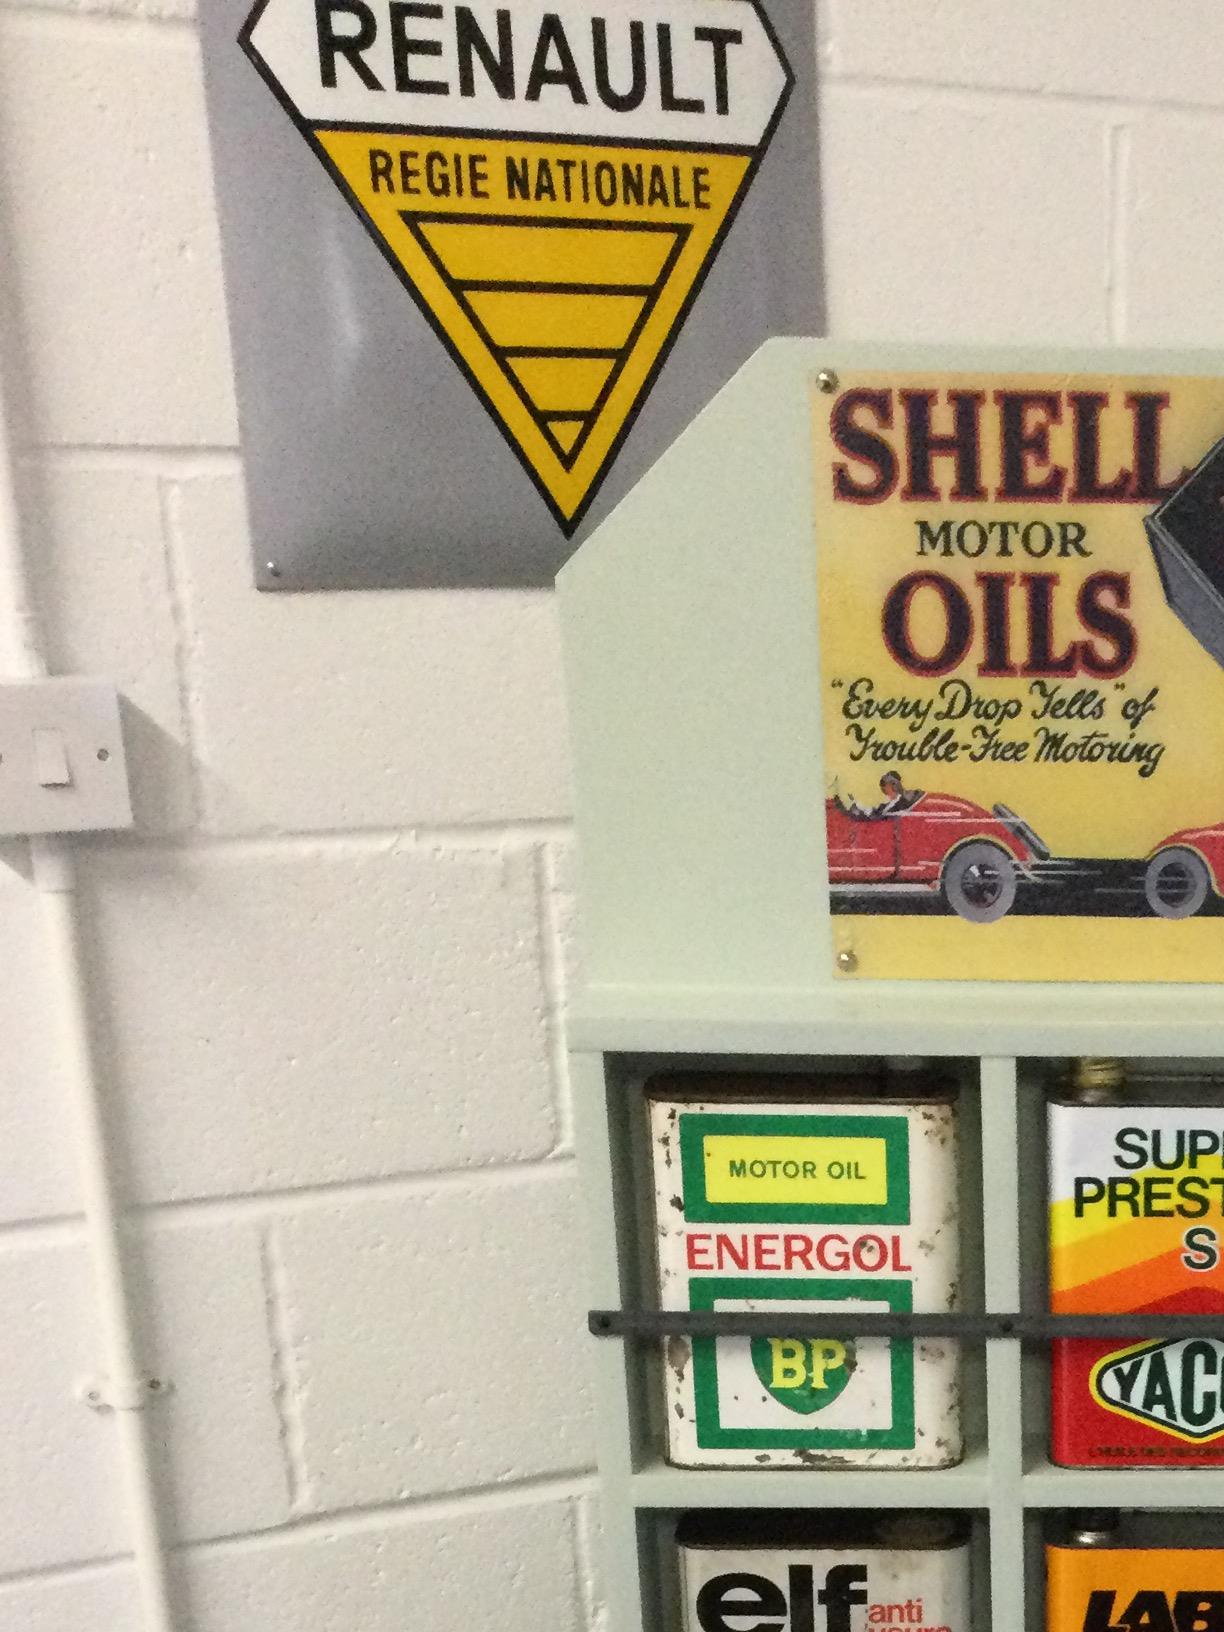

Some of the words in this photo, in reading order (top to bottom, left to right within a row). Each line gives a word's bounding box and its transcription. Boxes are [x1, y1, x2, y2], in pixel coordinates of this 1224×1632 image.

[315, 0, 743, 116] RENAULT
[369, 148, 490, 199] REGIE
[506, 155, 712, 211] NATIONALE
[830, 387, 1192, 506] SHELL
[915, 520, 1093, 559] MOTOR
[881, 570, 1138, 680] OILS
[935, 678, 1023, 724] Drop
[1120, 686, 1161, 730] of
[1033, 726, 1166, 778] Motoring
[729, 1158, 817, 1180] MOTOR
[827, 1160, 867, 1180] OIL
[686, 1233, 912, 1272] ENERGOL
[1182, 1227, 1218, 1270] S
[768, 1337, 847, 1389] BP
[867, 1597, 924, 1624] anti
